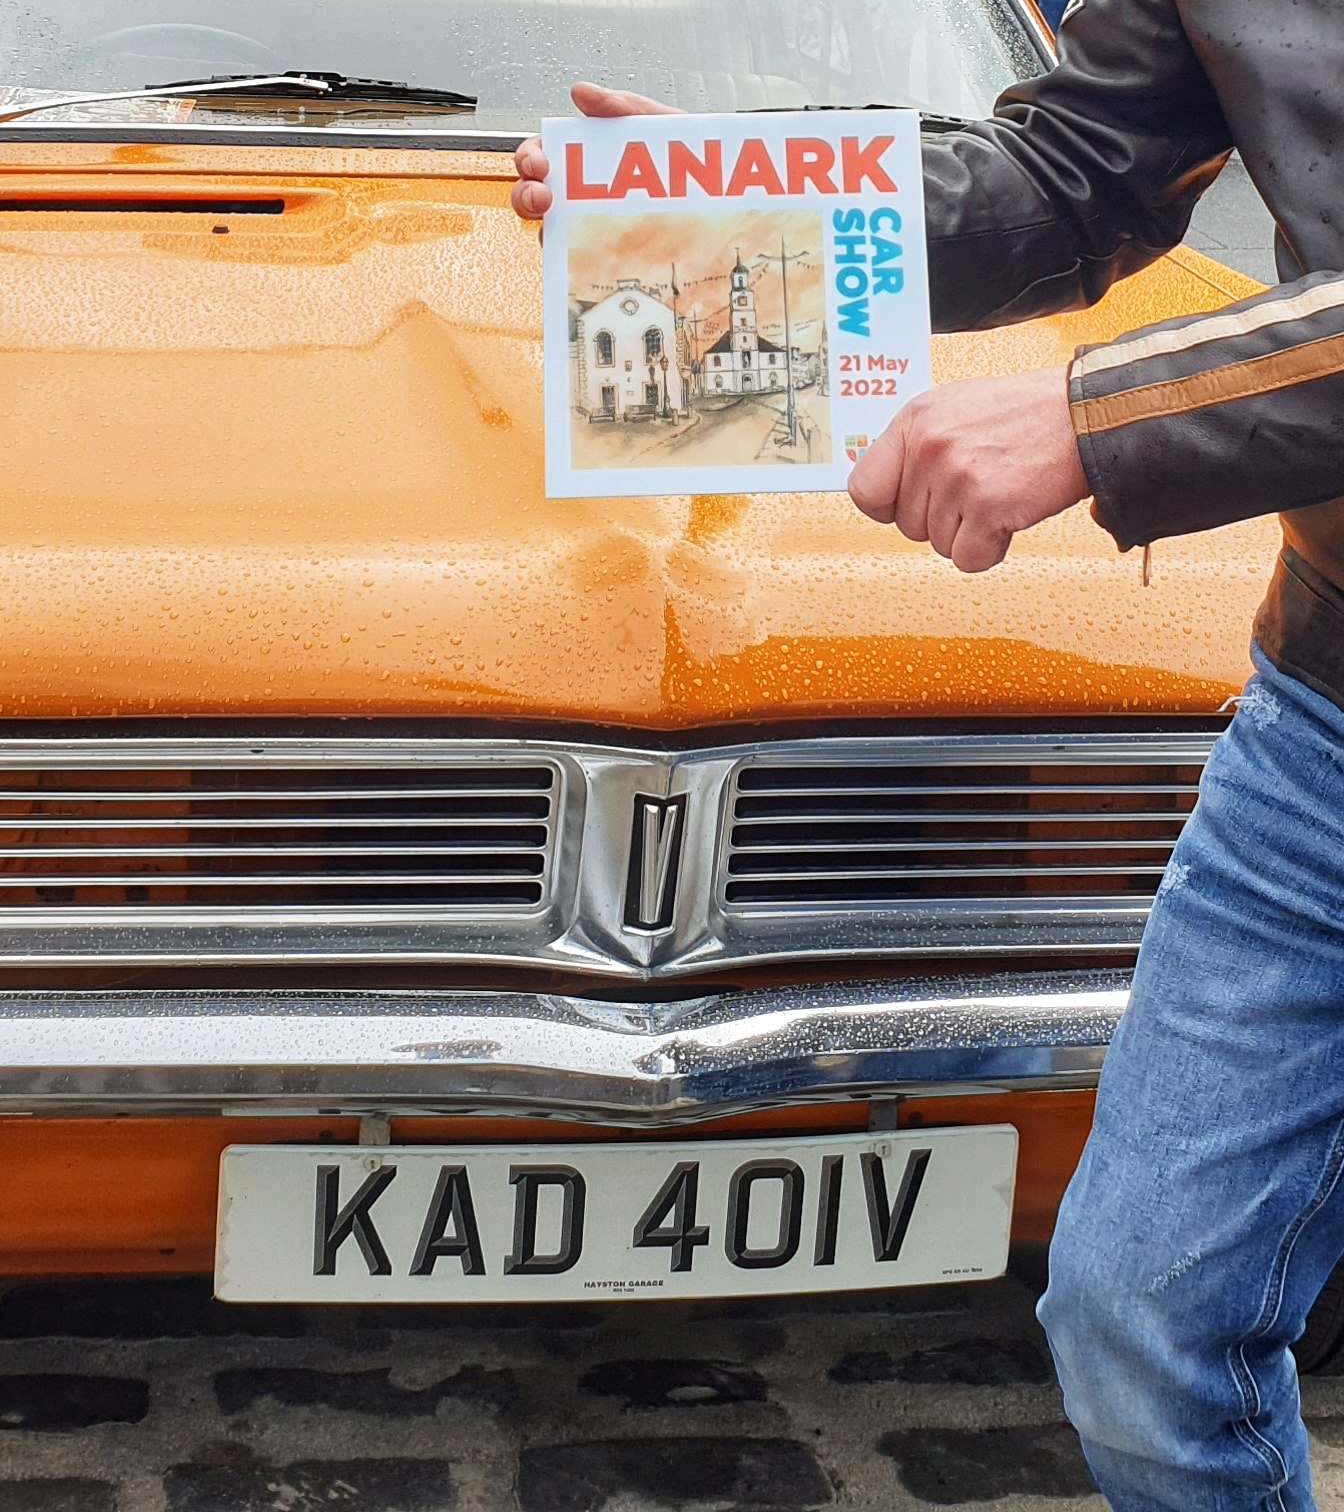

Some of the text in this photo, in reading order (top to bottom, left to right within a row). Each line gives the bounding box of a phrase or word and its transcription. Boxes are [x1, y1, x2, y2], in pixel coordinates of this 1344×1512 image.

[565, 135, 899, 201] LANARK
[832, 207, 871, 338] SHOW
[868, 206, 905, 297] CAR
[839, 354, 910, 375] 21 May
[840, 379, 898, 397] 2022
[312, 1148, 933, 1277] KAD 401V
[583, 1281, 626, 1289] HAYSTON
